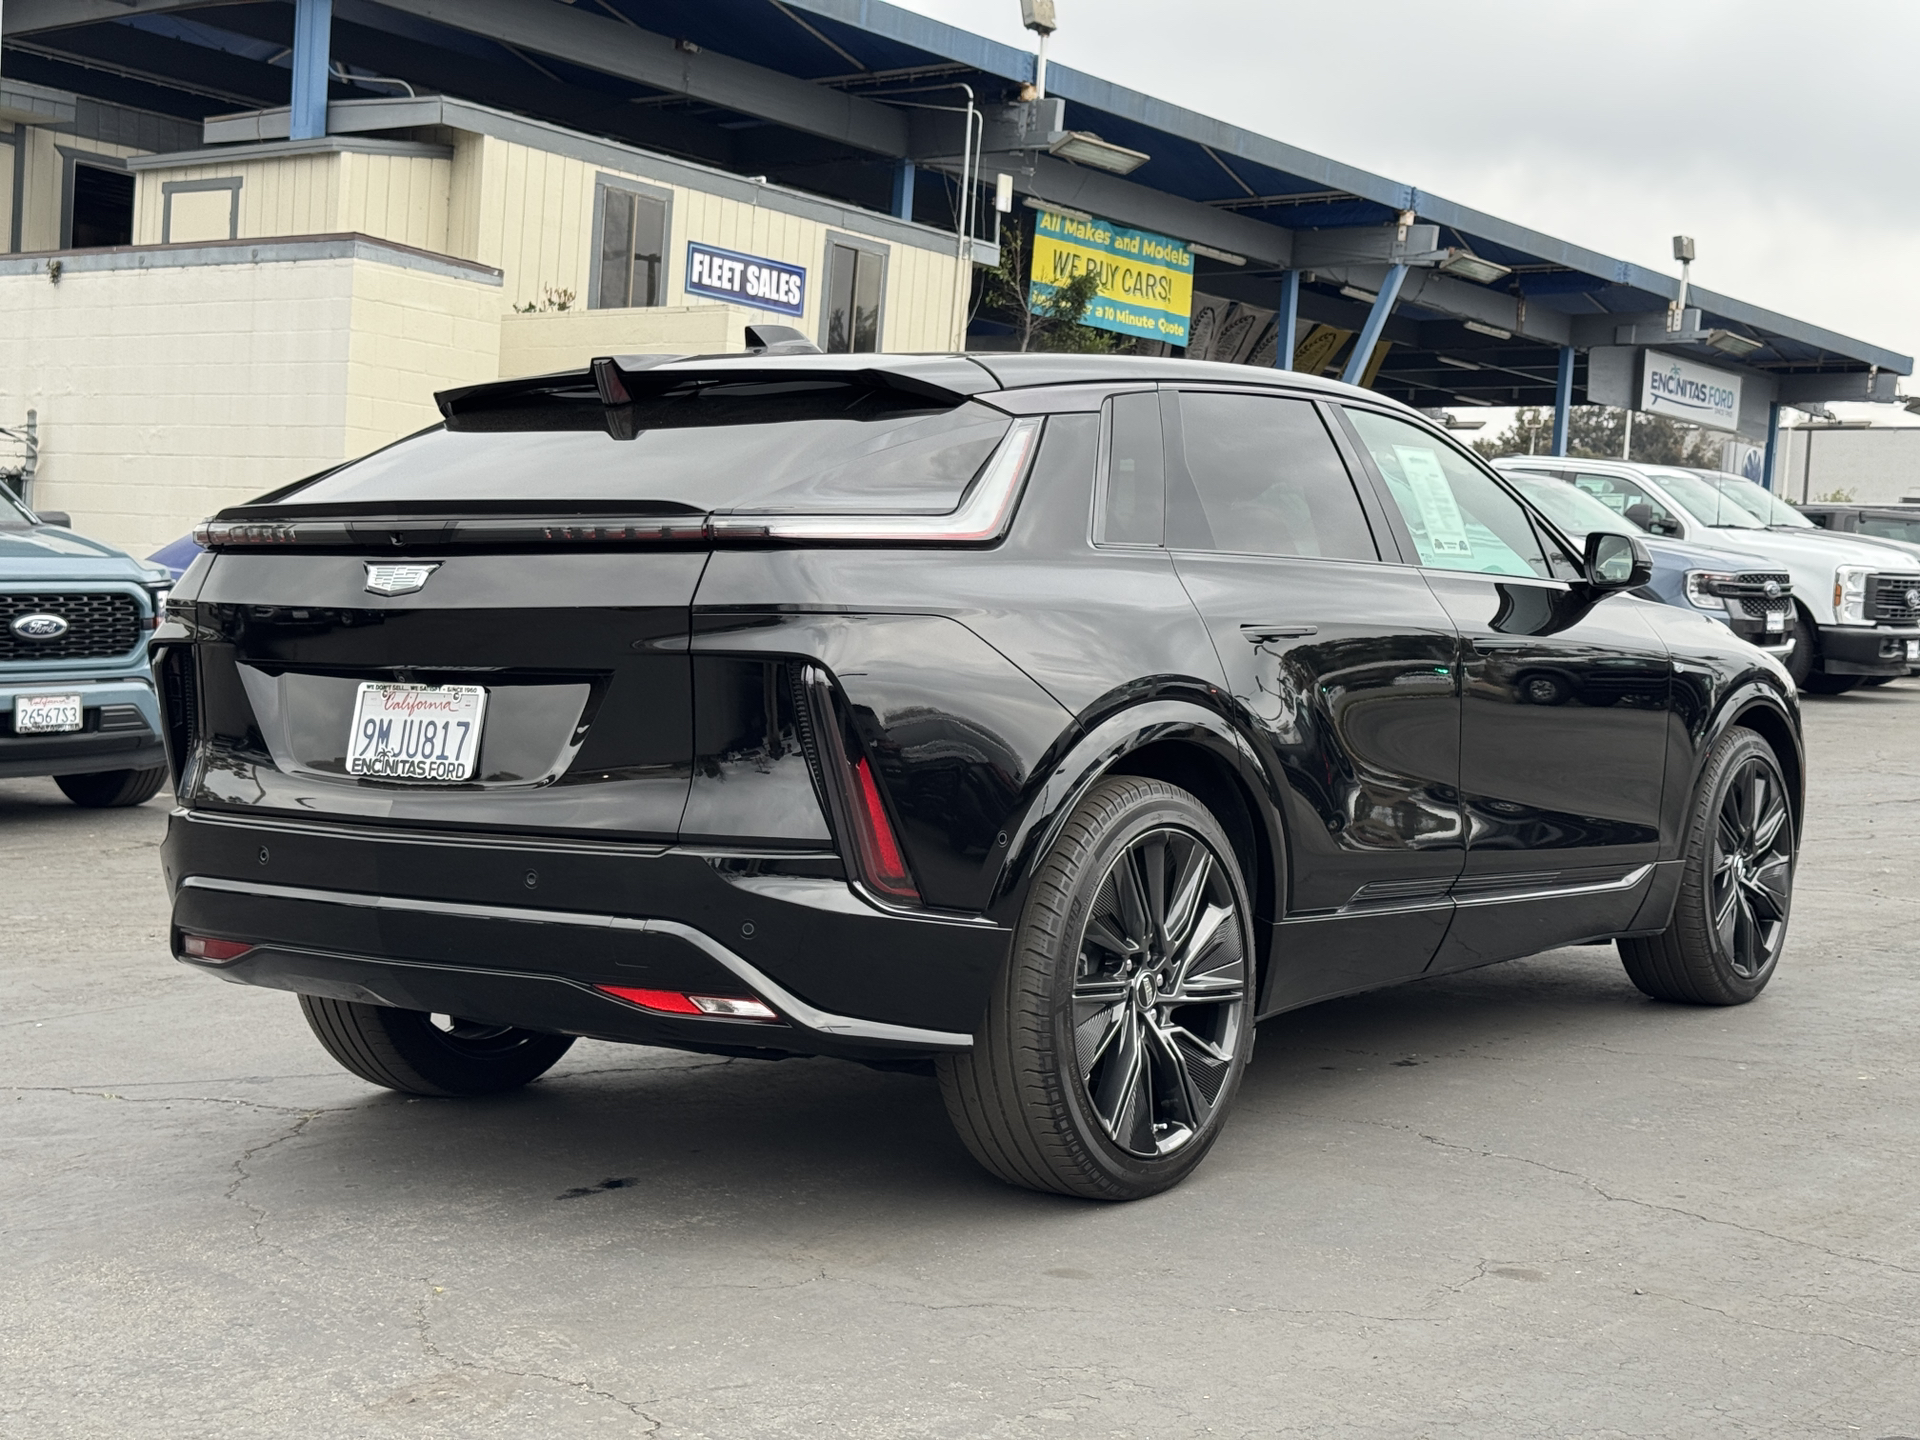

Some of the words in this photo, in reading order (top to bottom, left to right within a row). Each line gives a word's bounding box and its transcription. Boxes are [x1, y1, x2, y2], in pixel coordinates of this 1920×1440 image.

[1040, 212, 1061, 232] All
[1064, 218, 1111, 246] Makes
[1114, 236, 1141, 254] and
[1142, 239, 1190, 267] Models
[692, 252, 744, 292] FLEET
[746, 265, 801, 305] SALES
[1053, 249, 1082, 280] WE
[1122, 267, 1172, 304] CARS!
[1095, 306, 1104, 318] a
[1104, 306, 1114, 321] 10
[1116, 311, 1156, 329] Minute
[1158, 319, 1185, 337] Quote
[1650, 371, 1707, 403] ENCINITAS
[1707, 385, 1735, 409] FORD
[29, 620, 56, 634] Ford
[384, 691, 459, 717] California
[359, 718, 471, 761] 9MJU817
[351, 757, 427, 776] ENCINITAS
[428, 761, 466, 779] FORD
